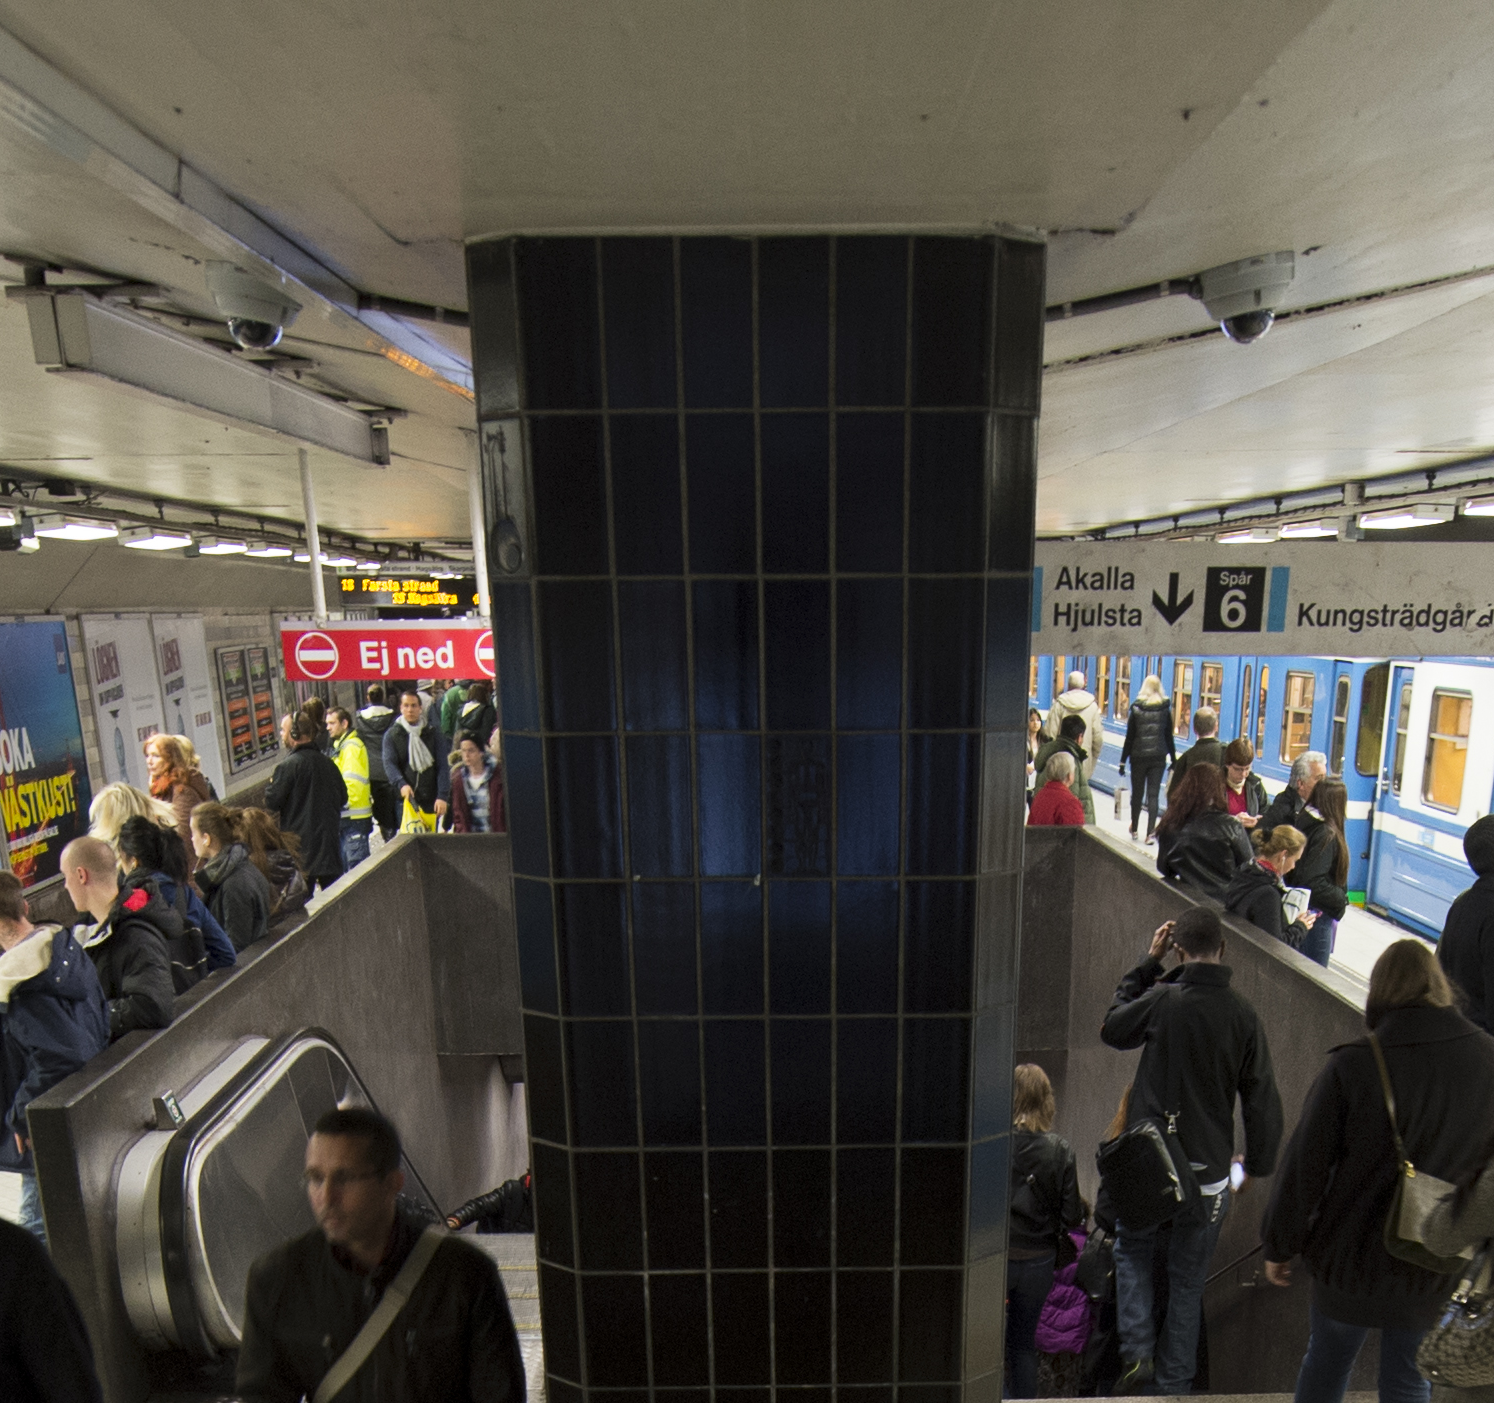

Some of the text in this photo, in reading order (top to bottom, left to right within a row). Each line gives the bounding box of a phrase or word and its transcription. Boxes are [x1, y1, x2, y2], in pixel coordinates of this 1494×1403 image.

[362, 579, 400, 592] Farsta
[402, 579, 440, 592] strand
[1054, 566, 1136, 591] Akalla
[1219, 571, 1253, 587] Spår
[1053, 602, 1142, 632] Hjulsta
[1220, 588, 1247, 628] 6
[359, 640, 455, 676] Ej ned
